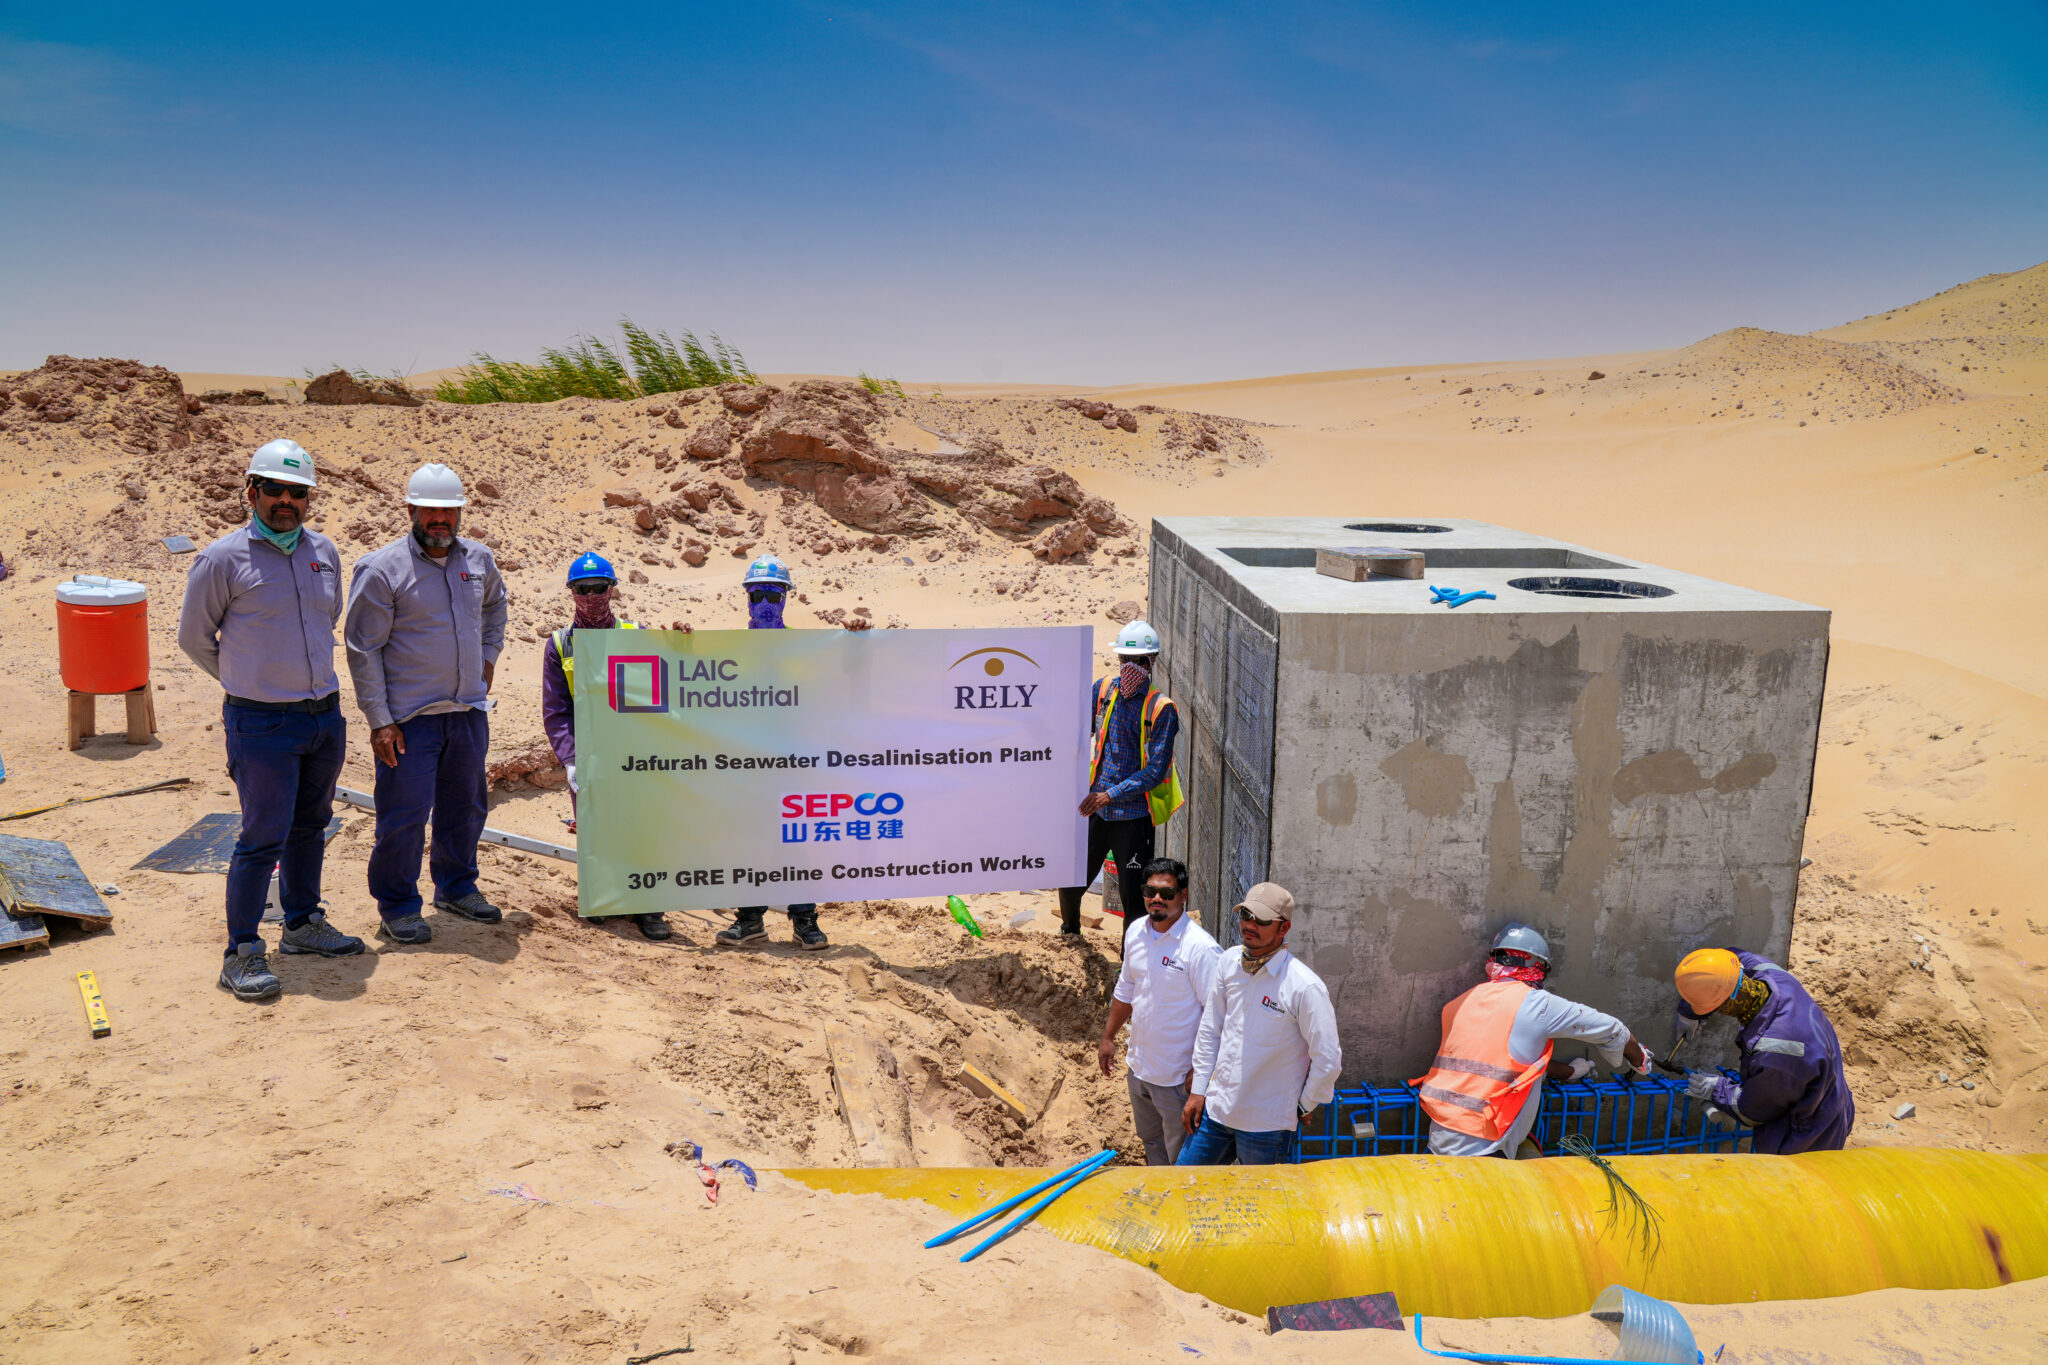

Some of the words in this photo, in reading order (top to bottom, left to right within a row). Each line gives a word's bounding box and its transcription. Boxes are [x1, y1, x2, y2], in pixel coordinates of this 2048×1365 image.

[679, 659, 738, 682] LAIC
[679, 685, 799, 708] Industrial
[954, 684, 1039, 710] RELY
[621, 755, 708, 772] Jafurah
[714, 753, 820, 770] Seawater
[826, 748, 993, 767] Desalinisation
[1000, 746, 1052, 763] Plant
[782, 792, 904, 818] SEPCO
[782, 818, 904, 843] 山东电建
[675, 869, 725, 887] GRE
[732, 866, 823, 887] Pipeline
[831, 860, 973, 879] Construction
[979, 855, 1046, 872] Works
